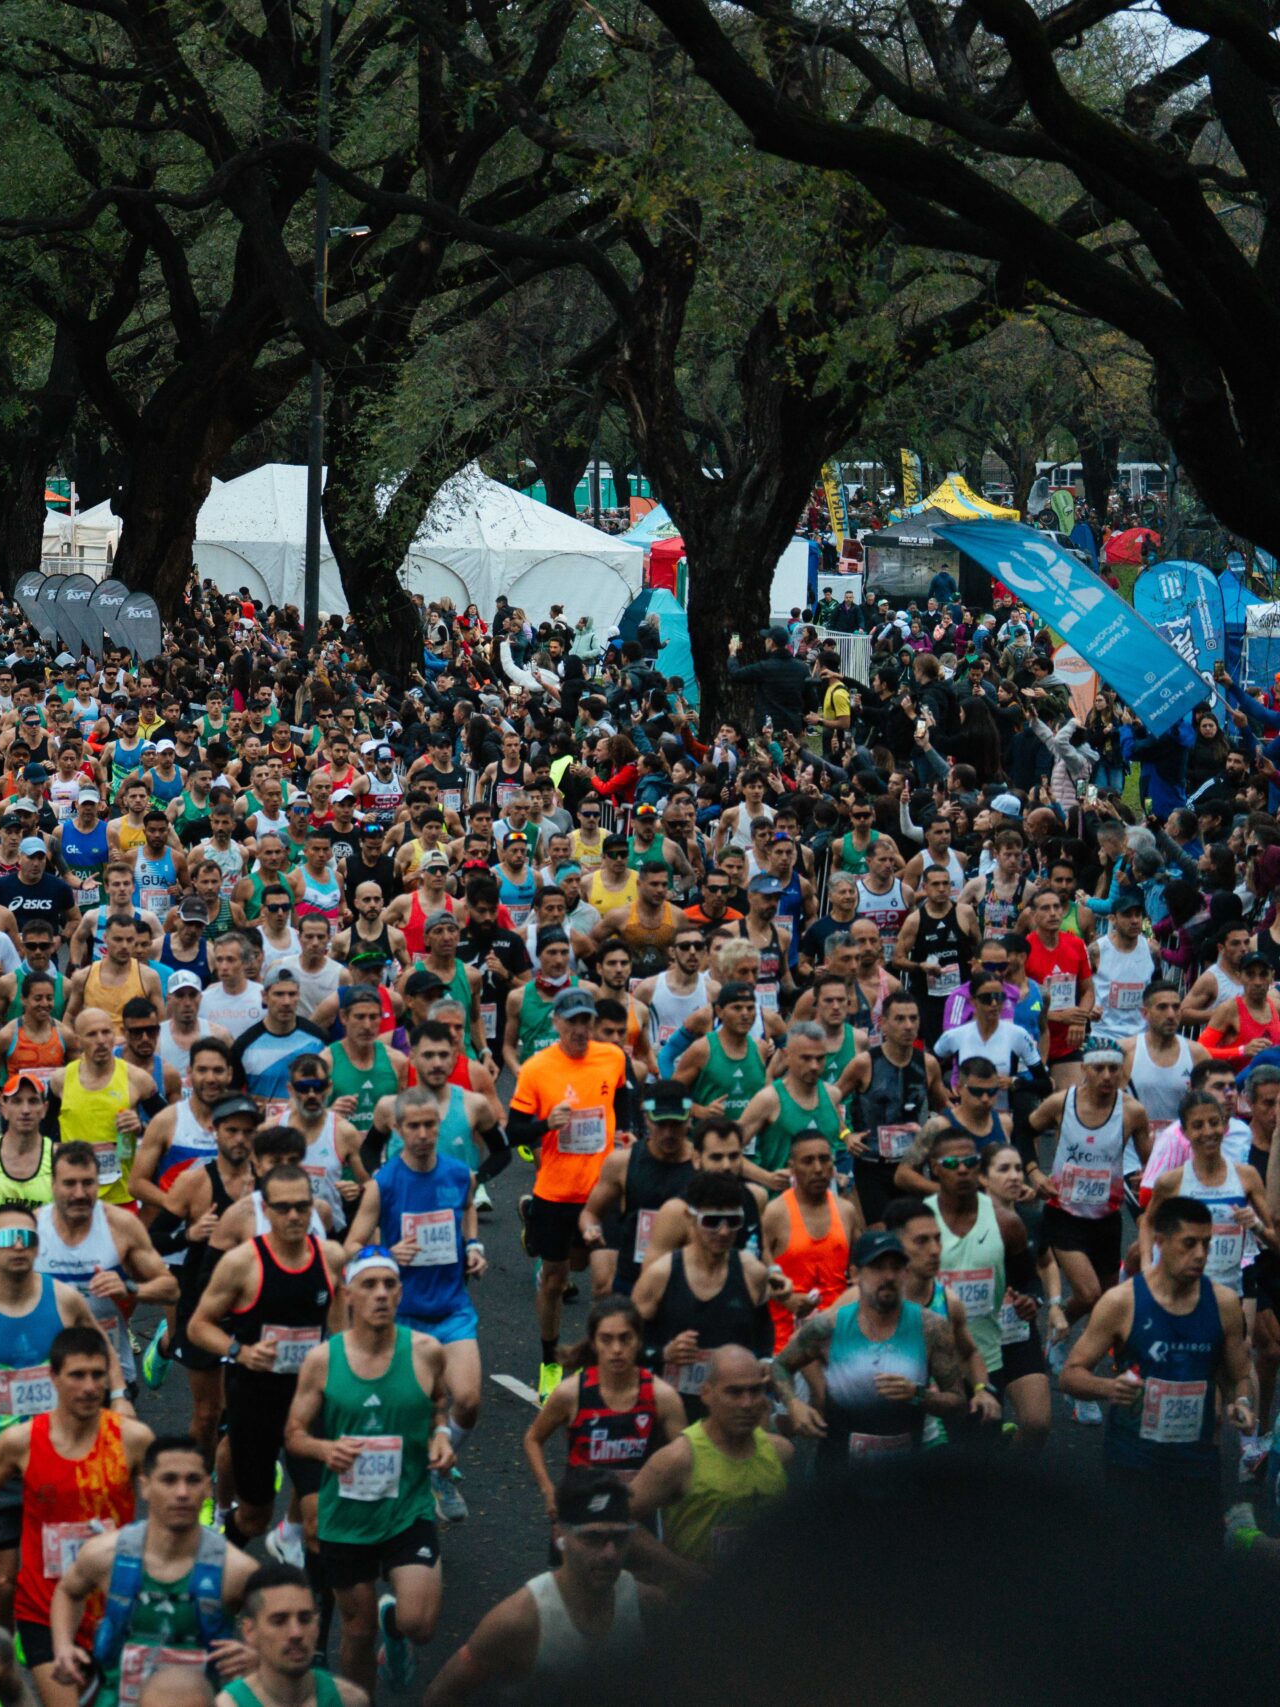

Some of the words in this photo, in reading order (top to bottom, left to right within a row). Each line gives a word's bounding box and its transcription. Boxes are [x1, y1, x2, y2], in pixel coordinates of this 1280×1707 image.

[141, 875, 168, 886] GUA
[720, 1100, 747, 1109] erson
[14, 1381, 50, 1405] 2433
[358, 1455, 395, 1477] 2364
[46, 1530, 56, 1551] C
